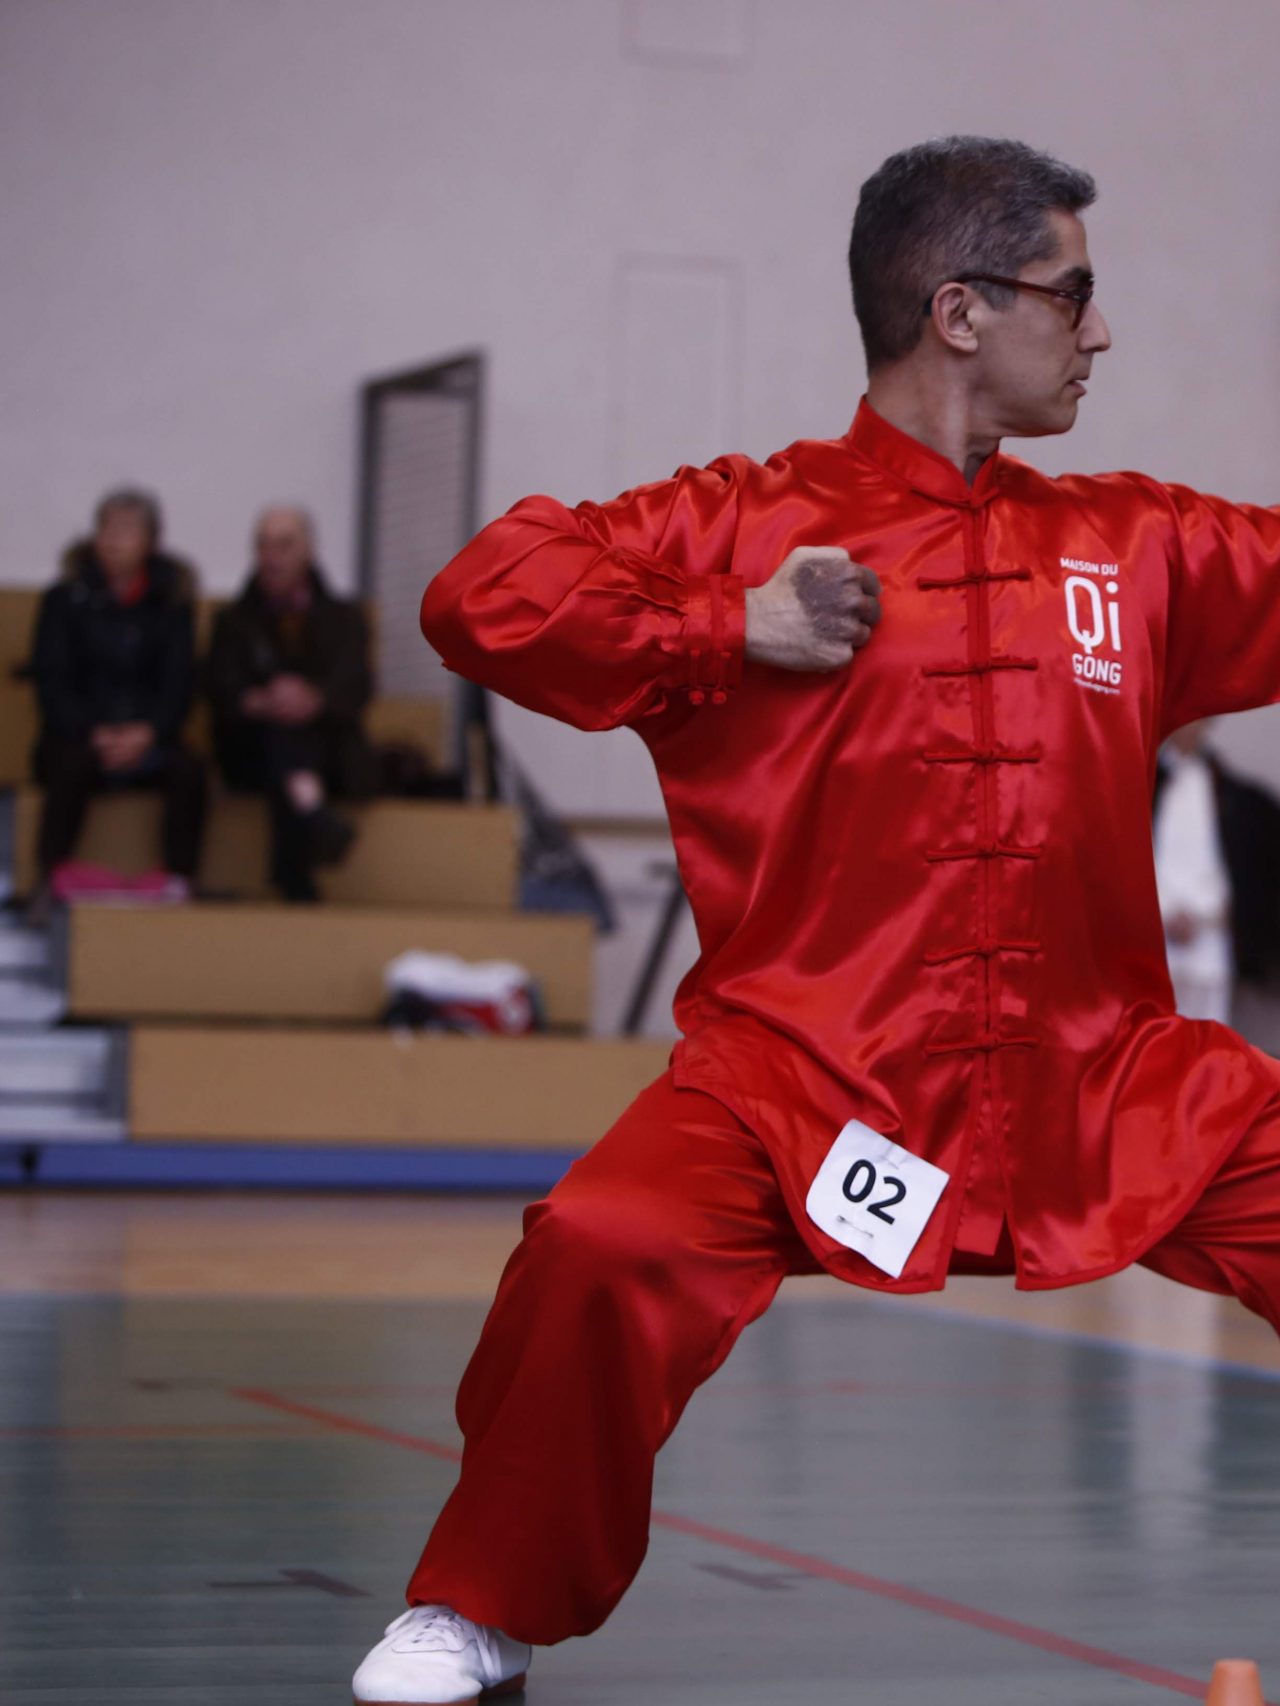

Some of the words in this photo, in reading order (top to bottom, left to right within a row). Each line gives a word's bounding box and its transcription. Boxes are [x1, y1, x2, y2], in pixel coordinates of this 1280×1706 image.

[1060, 557, 1099, 574] MAISON
[1101, 563, 1118, 576] DU
[1064, 575, 1121, 655] Qi
[1072, 653, 1122, 685] GONG
[842, 1159, 907, 1225] 02
